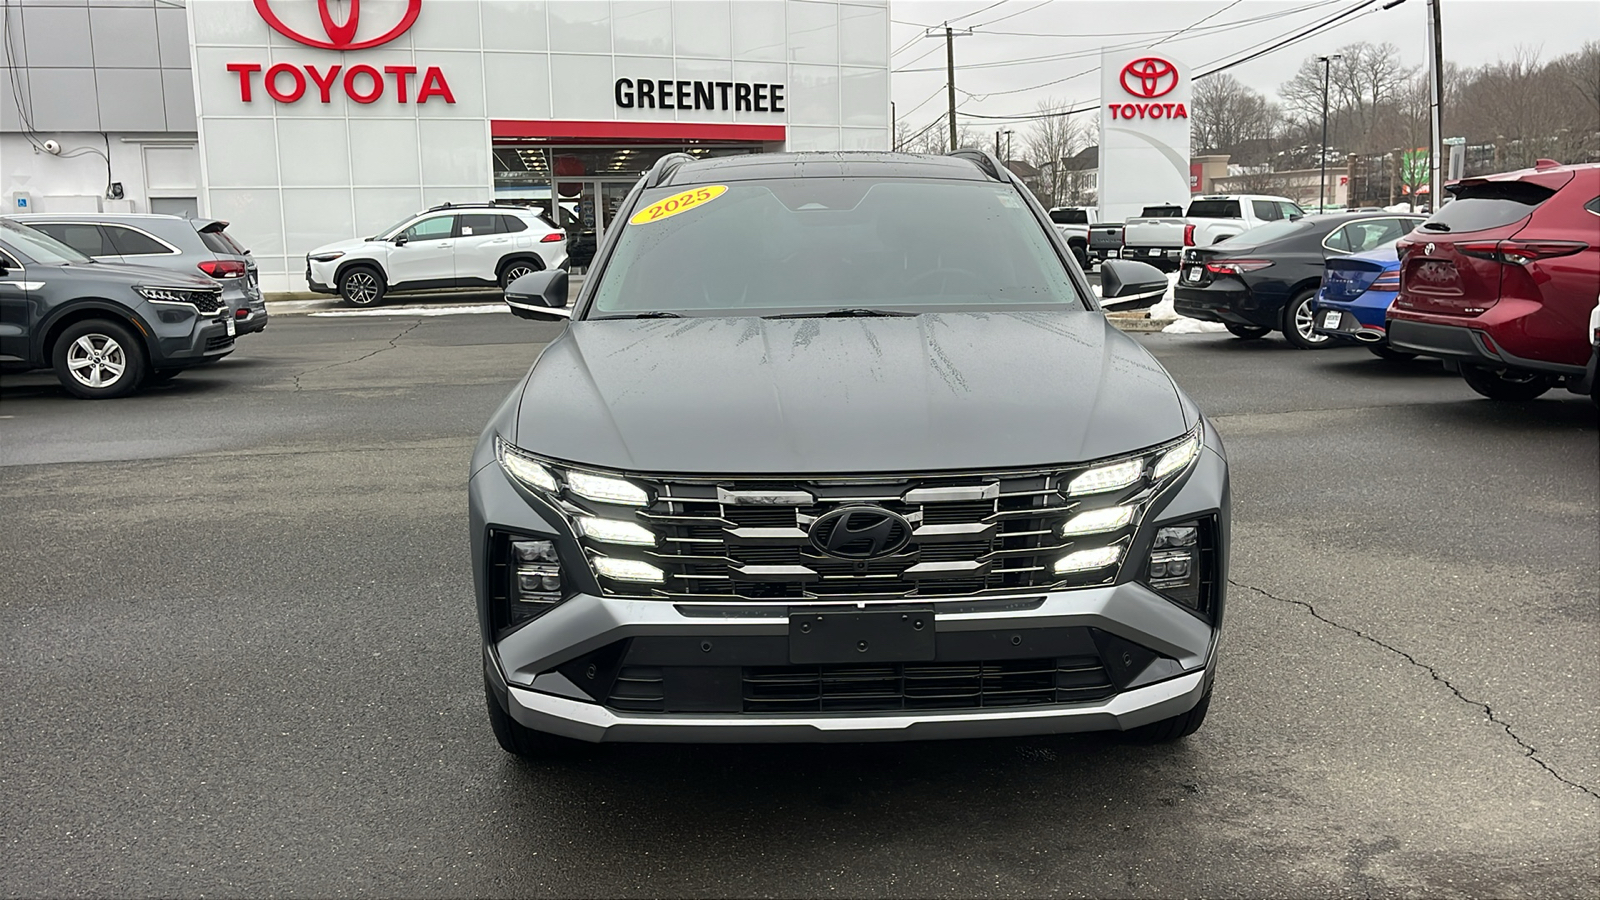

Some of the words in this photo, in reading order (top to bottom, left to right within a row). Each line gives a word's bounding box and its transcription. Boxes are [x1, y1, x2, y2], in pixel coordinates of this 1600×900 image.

[226, 62, 455, 104] TOYOTA
[614, 78, 786, 112] GREENTREE
[1109, 102, 1188, 120] TOYOTA
[649, 188, 711, 219] 2025
